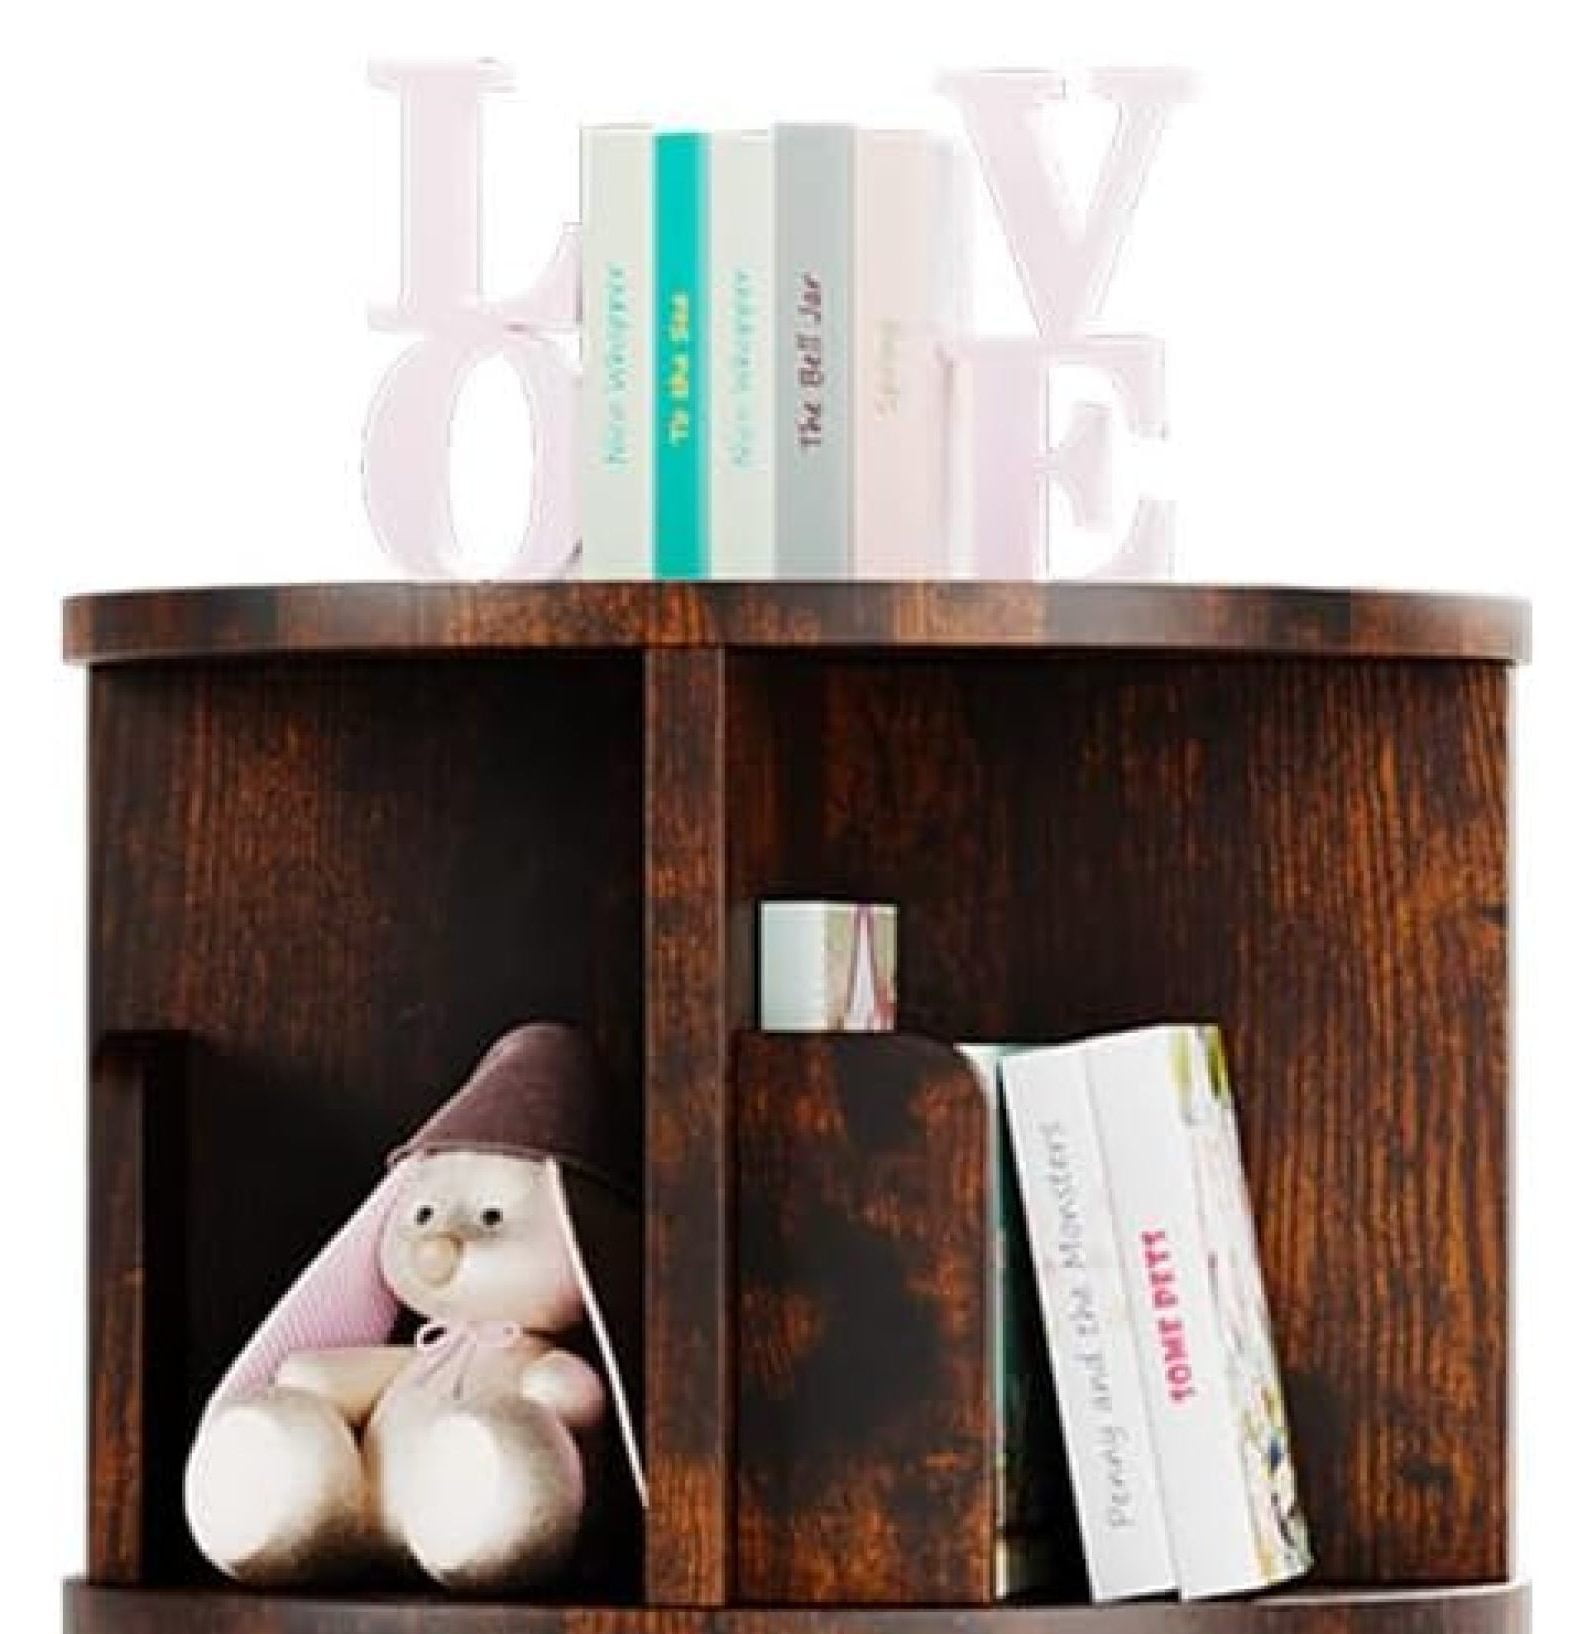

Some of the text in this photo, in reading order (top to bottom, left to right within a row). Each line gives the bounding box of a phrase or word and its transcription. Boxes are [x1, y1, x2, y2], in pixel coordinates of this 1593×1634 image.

[665, 292, 690, 444] To the Sea
[796, 271, 822, 448] The Bell Jar
[1040, 1119, 1137, 1531] Penny and the Monsters
[1153, 1316, 1197, 1404] SOME
